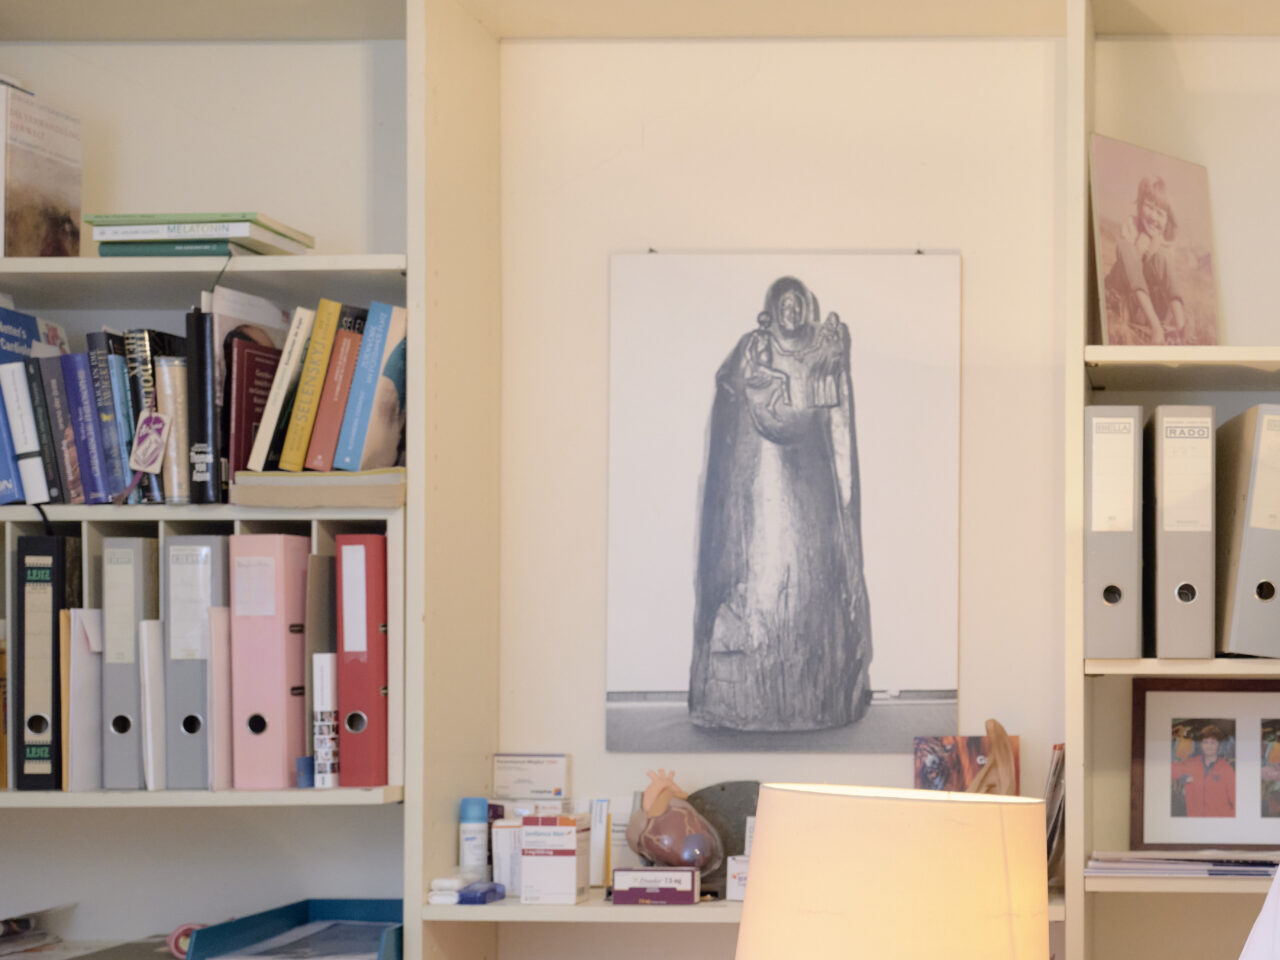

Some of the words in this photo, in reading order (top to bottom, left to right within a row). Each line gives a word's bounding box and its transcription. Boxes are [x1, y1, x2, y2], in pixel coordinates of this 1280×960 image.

[167, 223, 230, 235] MELATONIN
[296, 340, 326, 425] SELENSKYJ
[1168, 426, 1207, 438] RADO
